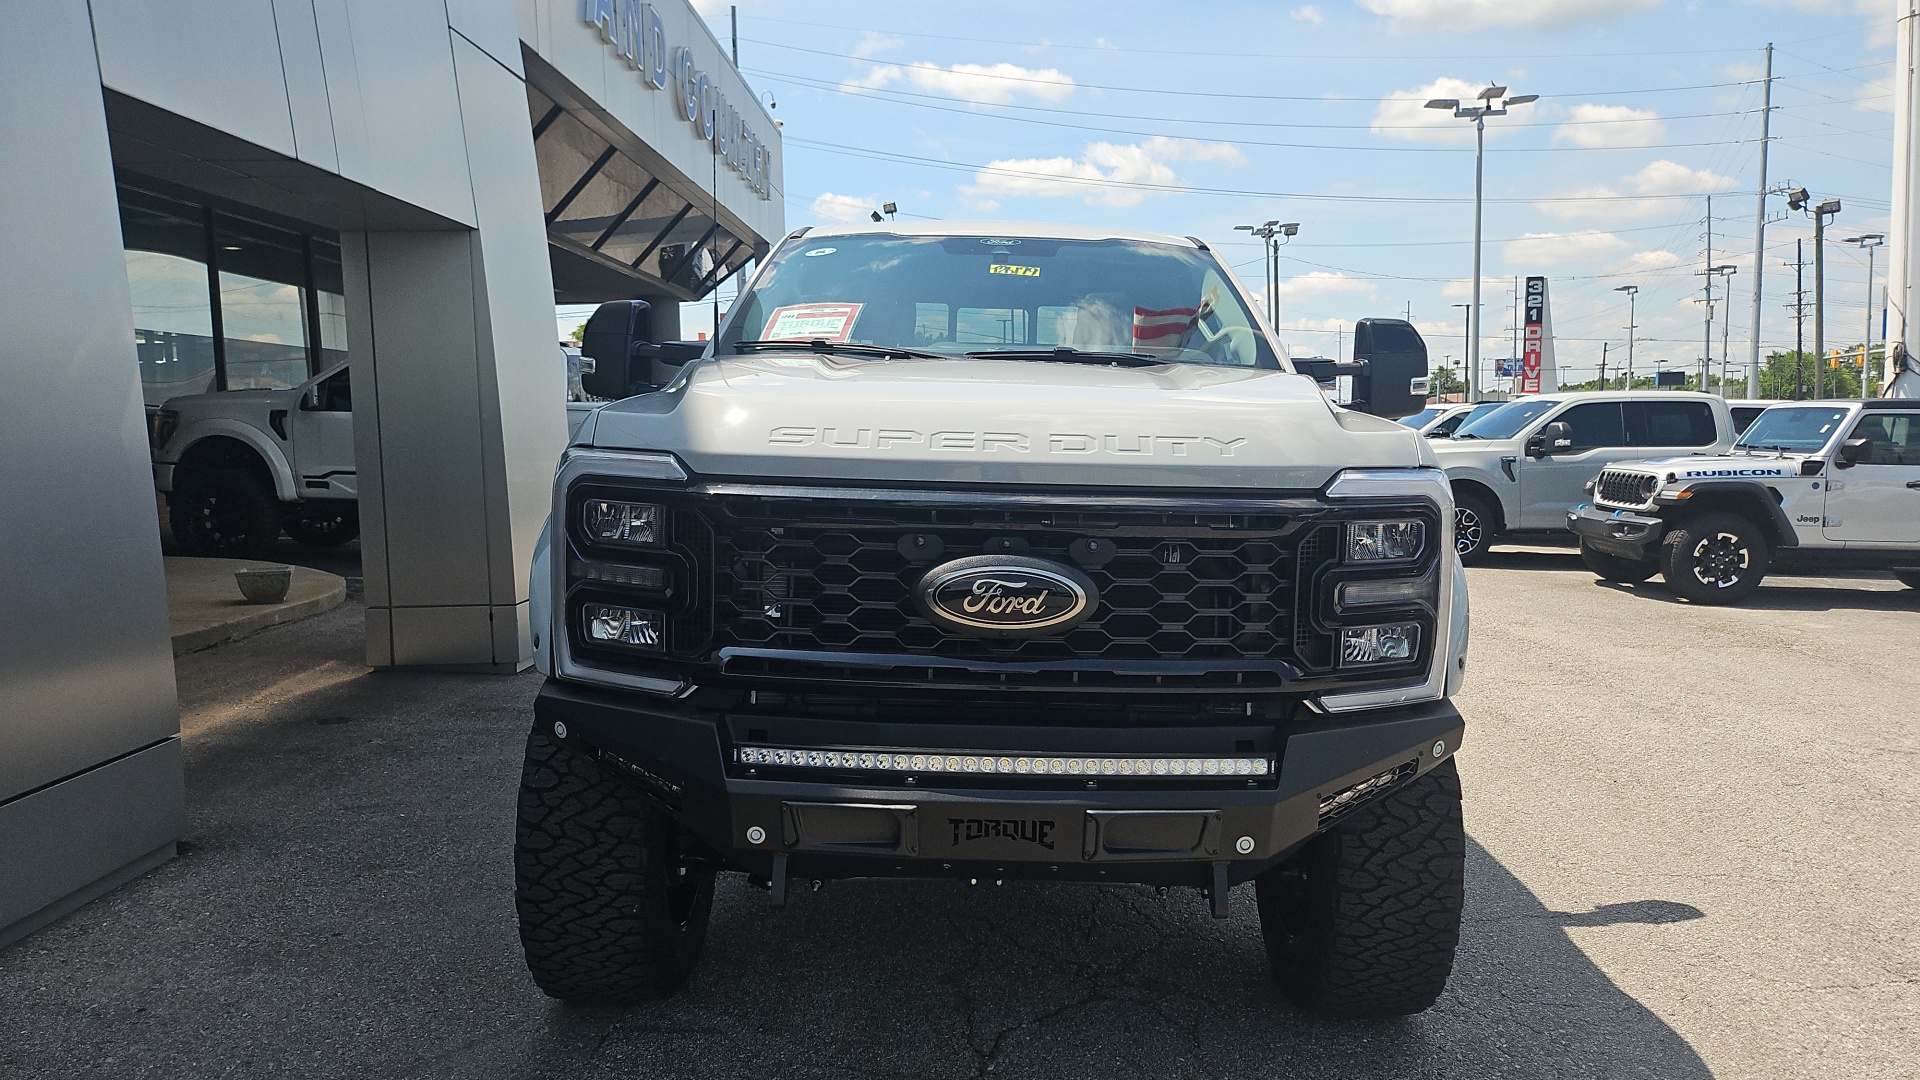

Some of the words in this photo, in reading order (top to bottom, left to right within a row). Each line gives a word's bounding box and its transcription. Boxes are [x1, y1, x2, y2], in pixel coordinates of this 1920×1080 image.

[1527, 280, 1543, 321] 321
[1524, 326, 1542, 392] DRIVE
[768, 425, 1031, 454] SUPER
[1048, 432, 1248, 457] DUTY
[1685, 468, 1783, 478] RUBICON
[1796, 514, 1820, 524] Jeep
[962, 578, 1049, 615] Ford
[946, 818, 1056, 851] TORQUE
